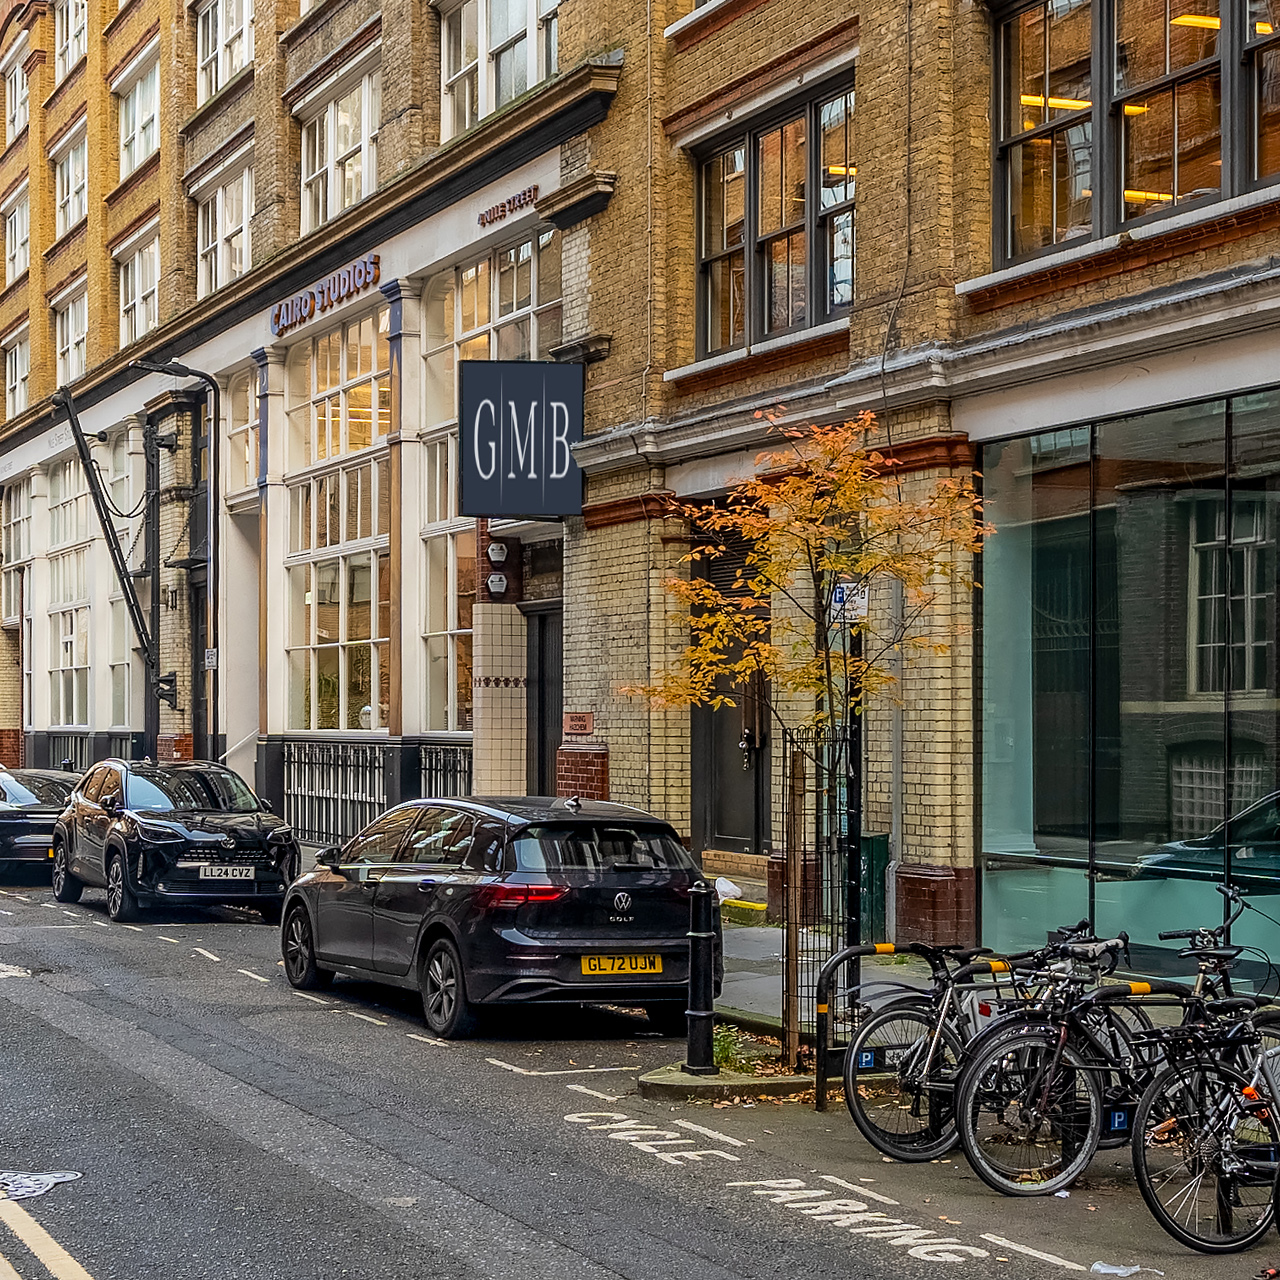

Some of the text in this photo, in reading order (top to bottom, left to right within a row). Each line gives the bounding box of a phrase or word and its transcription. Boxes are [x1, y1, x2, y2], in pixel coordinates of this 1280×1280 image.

[506, 184, 539, 214] STREET
[271, 254, 380, 337] CAIRO STUDIOS
[203, 868, 251, 878] LL24 CVZ
[588, 955, 656, 972] GL72 UJW
[564, 1112, 991, 1262] CYCLE PARKING
